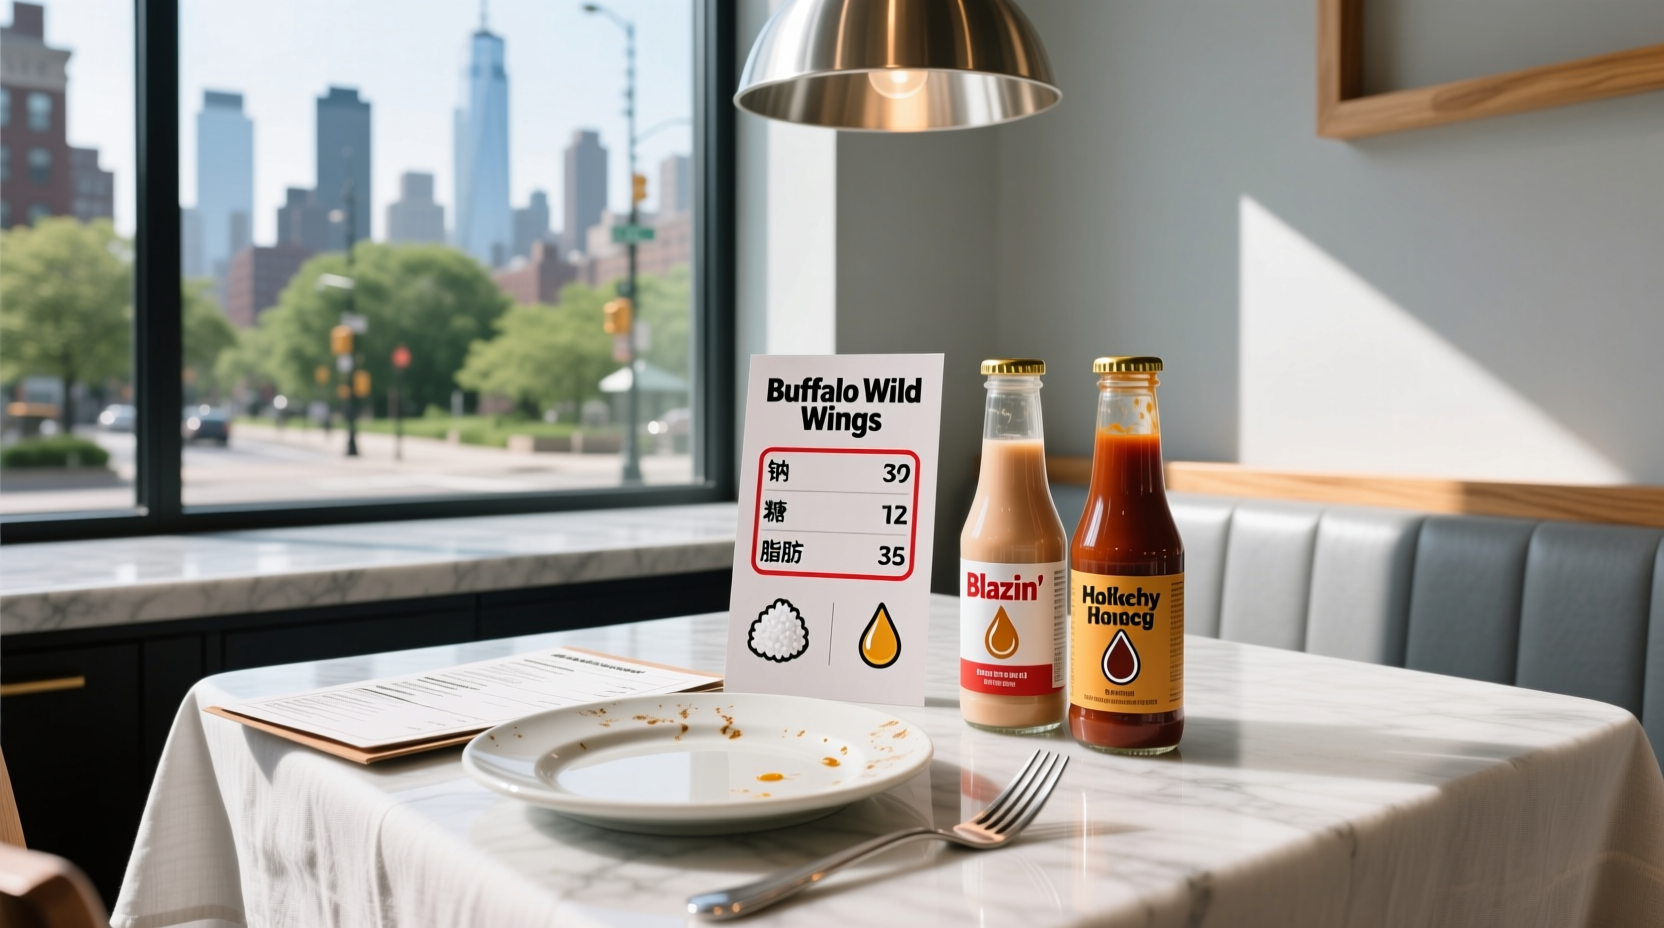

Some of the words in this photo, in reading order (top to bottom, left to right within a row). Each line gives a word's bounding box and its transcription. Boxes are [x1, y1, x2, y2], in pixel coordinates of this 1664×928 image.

[766, 377, 860, 403] Buffalo
[863, 377, 922, 403] Wild
[801, 405, 882, 438] Wings
[767, 459, 790, 482] 钠
[763, 500, 788, 523] 糖
[882, 505, 908, 525] 12
[760, 539, 804, 564] 脂肪
[877, 546, 905, 566] 35
